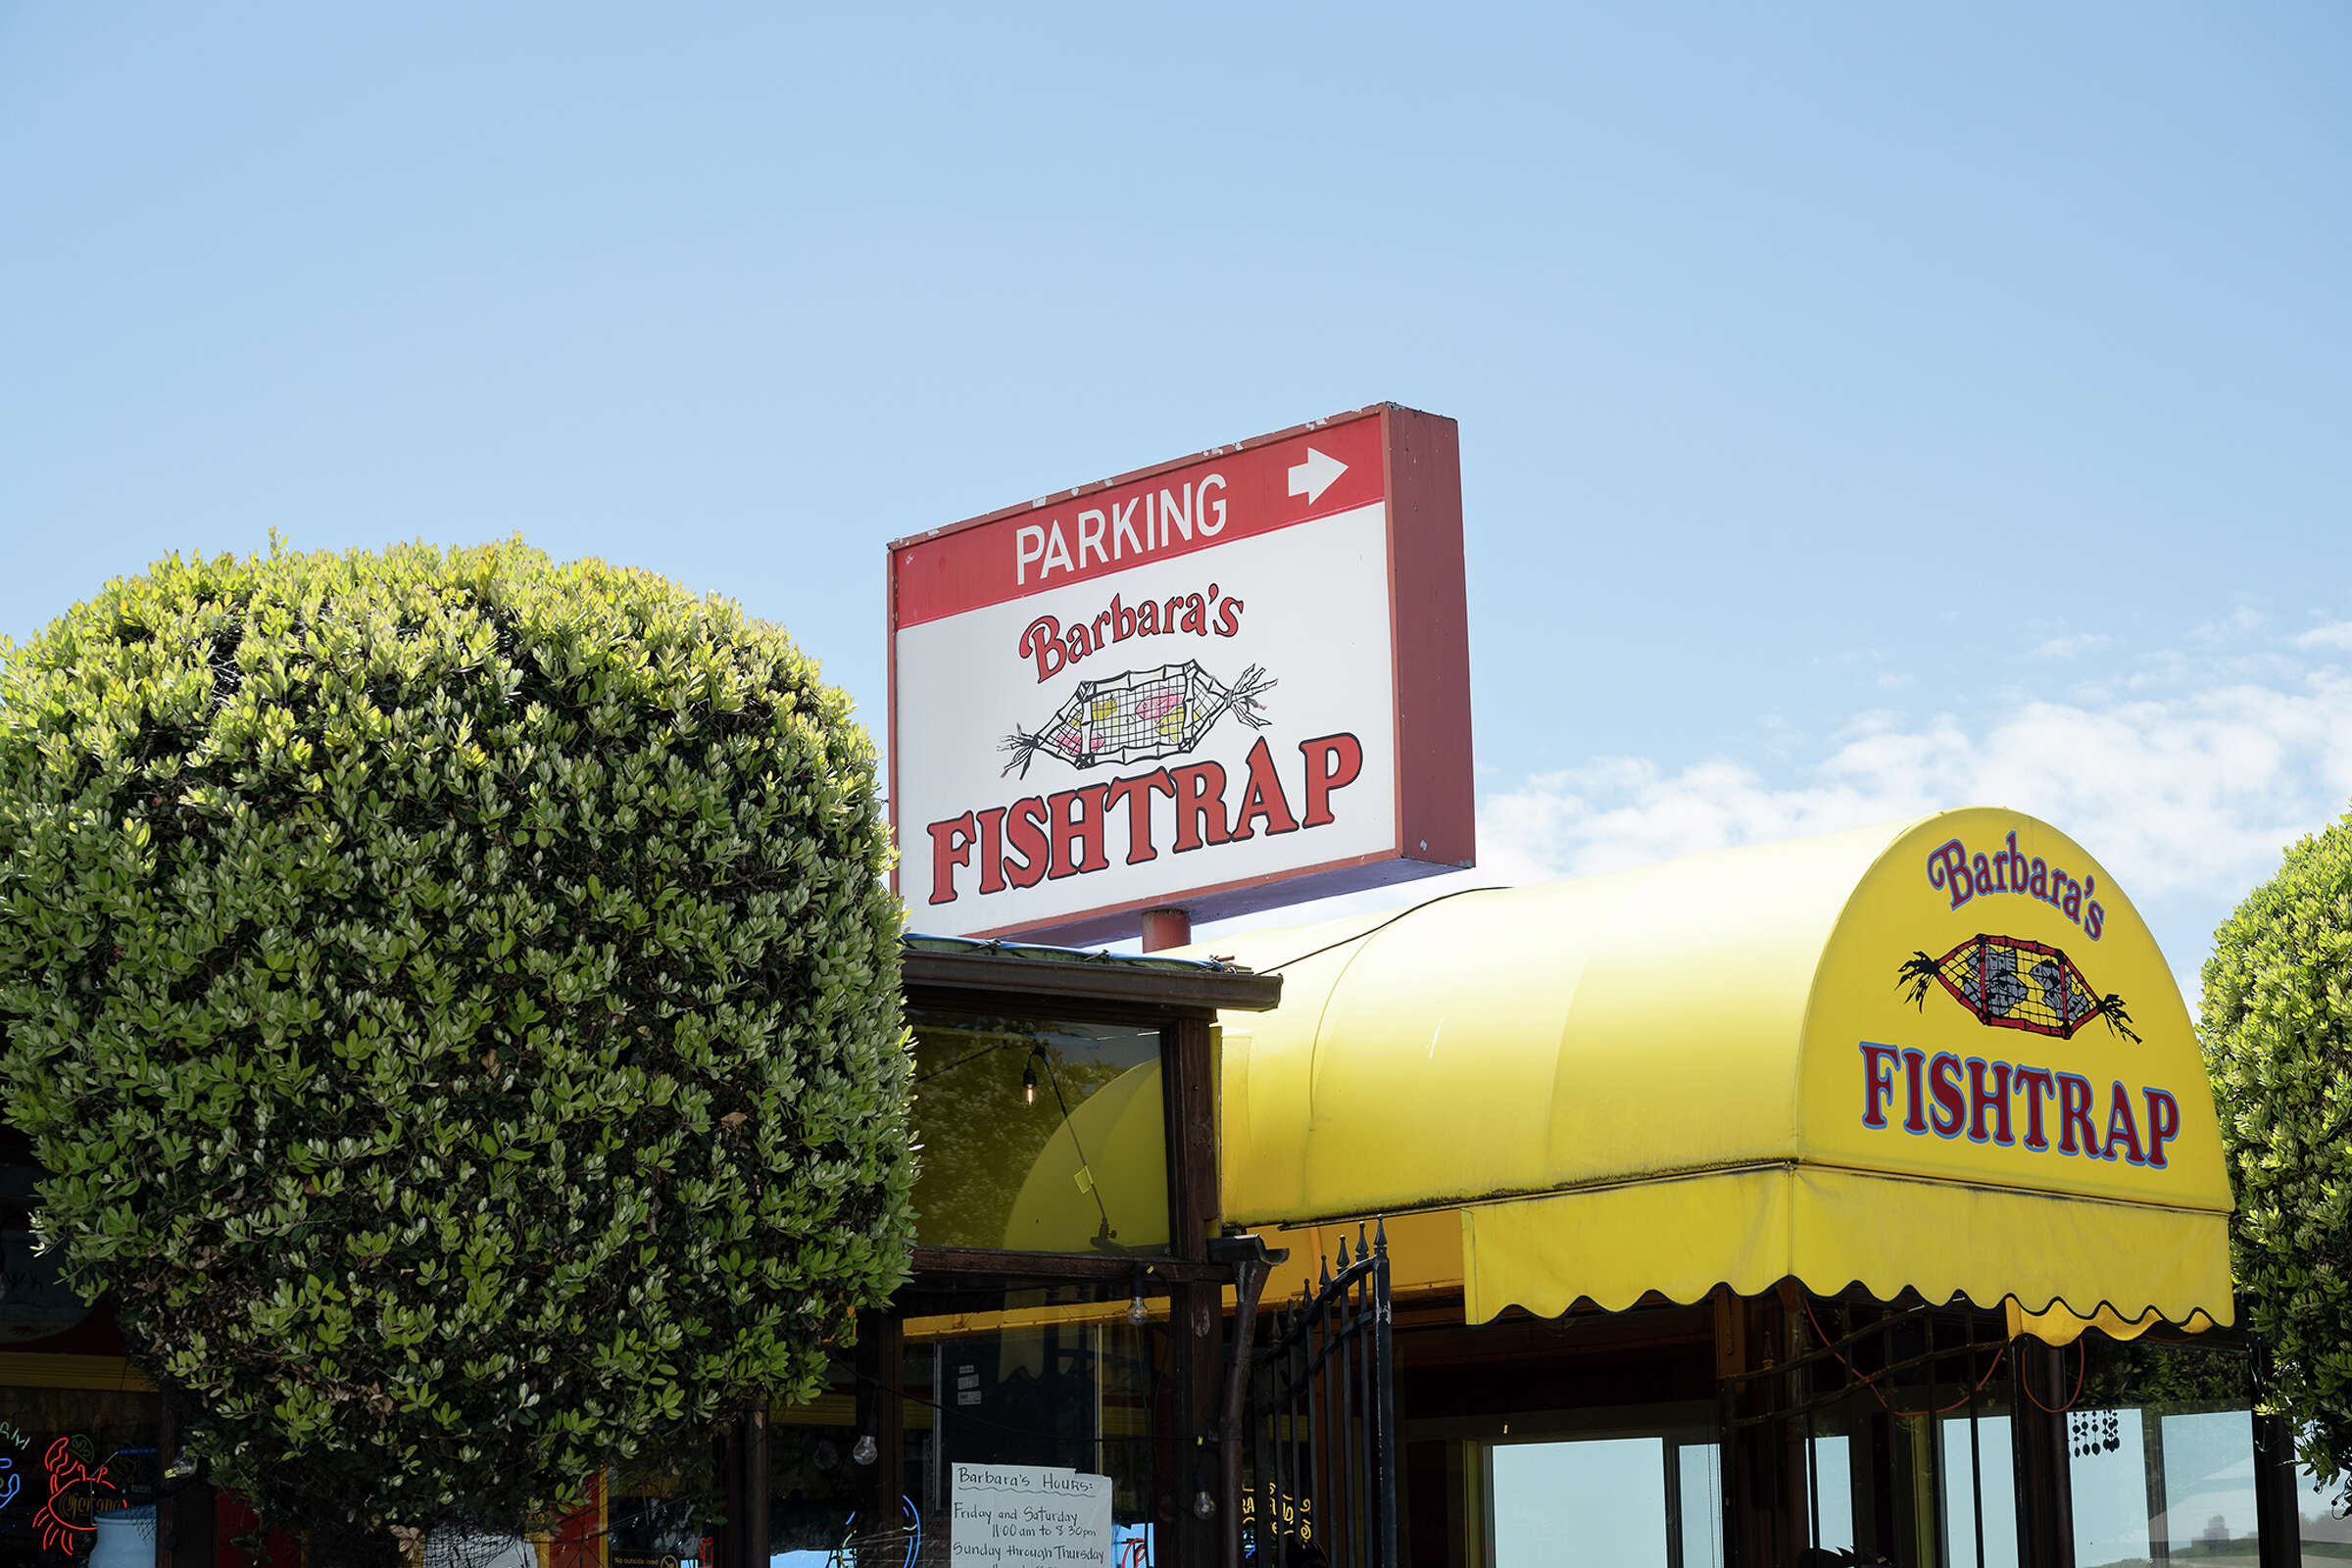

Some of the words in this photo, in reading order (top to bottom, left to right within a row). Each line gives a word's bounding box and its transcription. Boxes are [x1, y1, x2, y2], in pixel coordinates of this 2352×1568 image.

[1015, 473, 1227, 586] PARKING
[1018, 583, 1244, 684] Barbara's
[927, 731, 1363, 906] FISHTRAP
[1927, 831, 2104, 942] Barbara's
[1859, 1041, 2180, 1169] FISHTRAP
[954, 1501, 993, 1524] Friday
[998, 1510, 1017, 1519] and
[1023, 1505, 1078, 1523] Saturday
[957, 1466, 1030, 1488] Barbara's
[953, 1542, 1002, 1560] Sunday
[1006, 1544, 1053, 1560] through
[1054, 1545, 1104, 1564] Thursday
[1039, 1524, 1052, 1537] to
